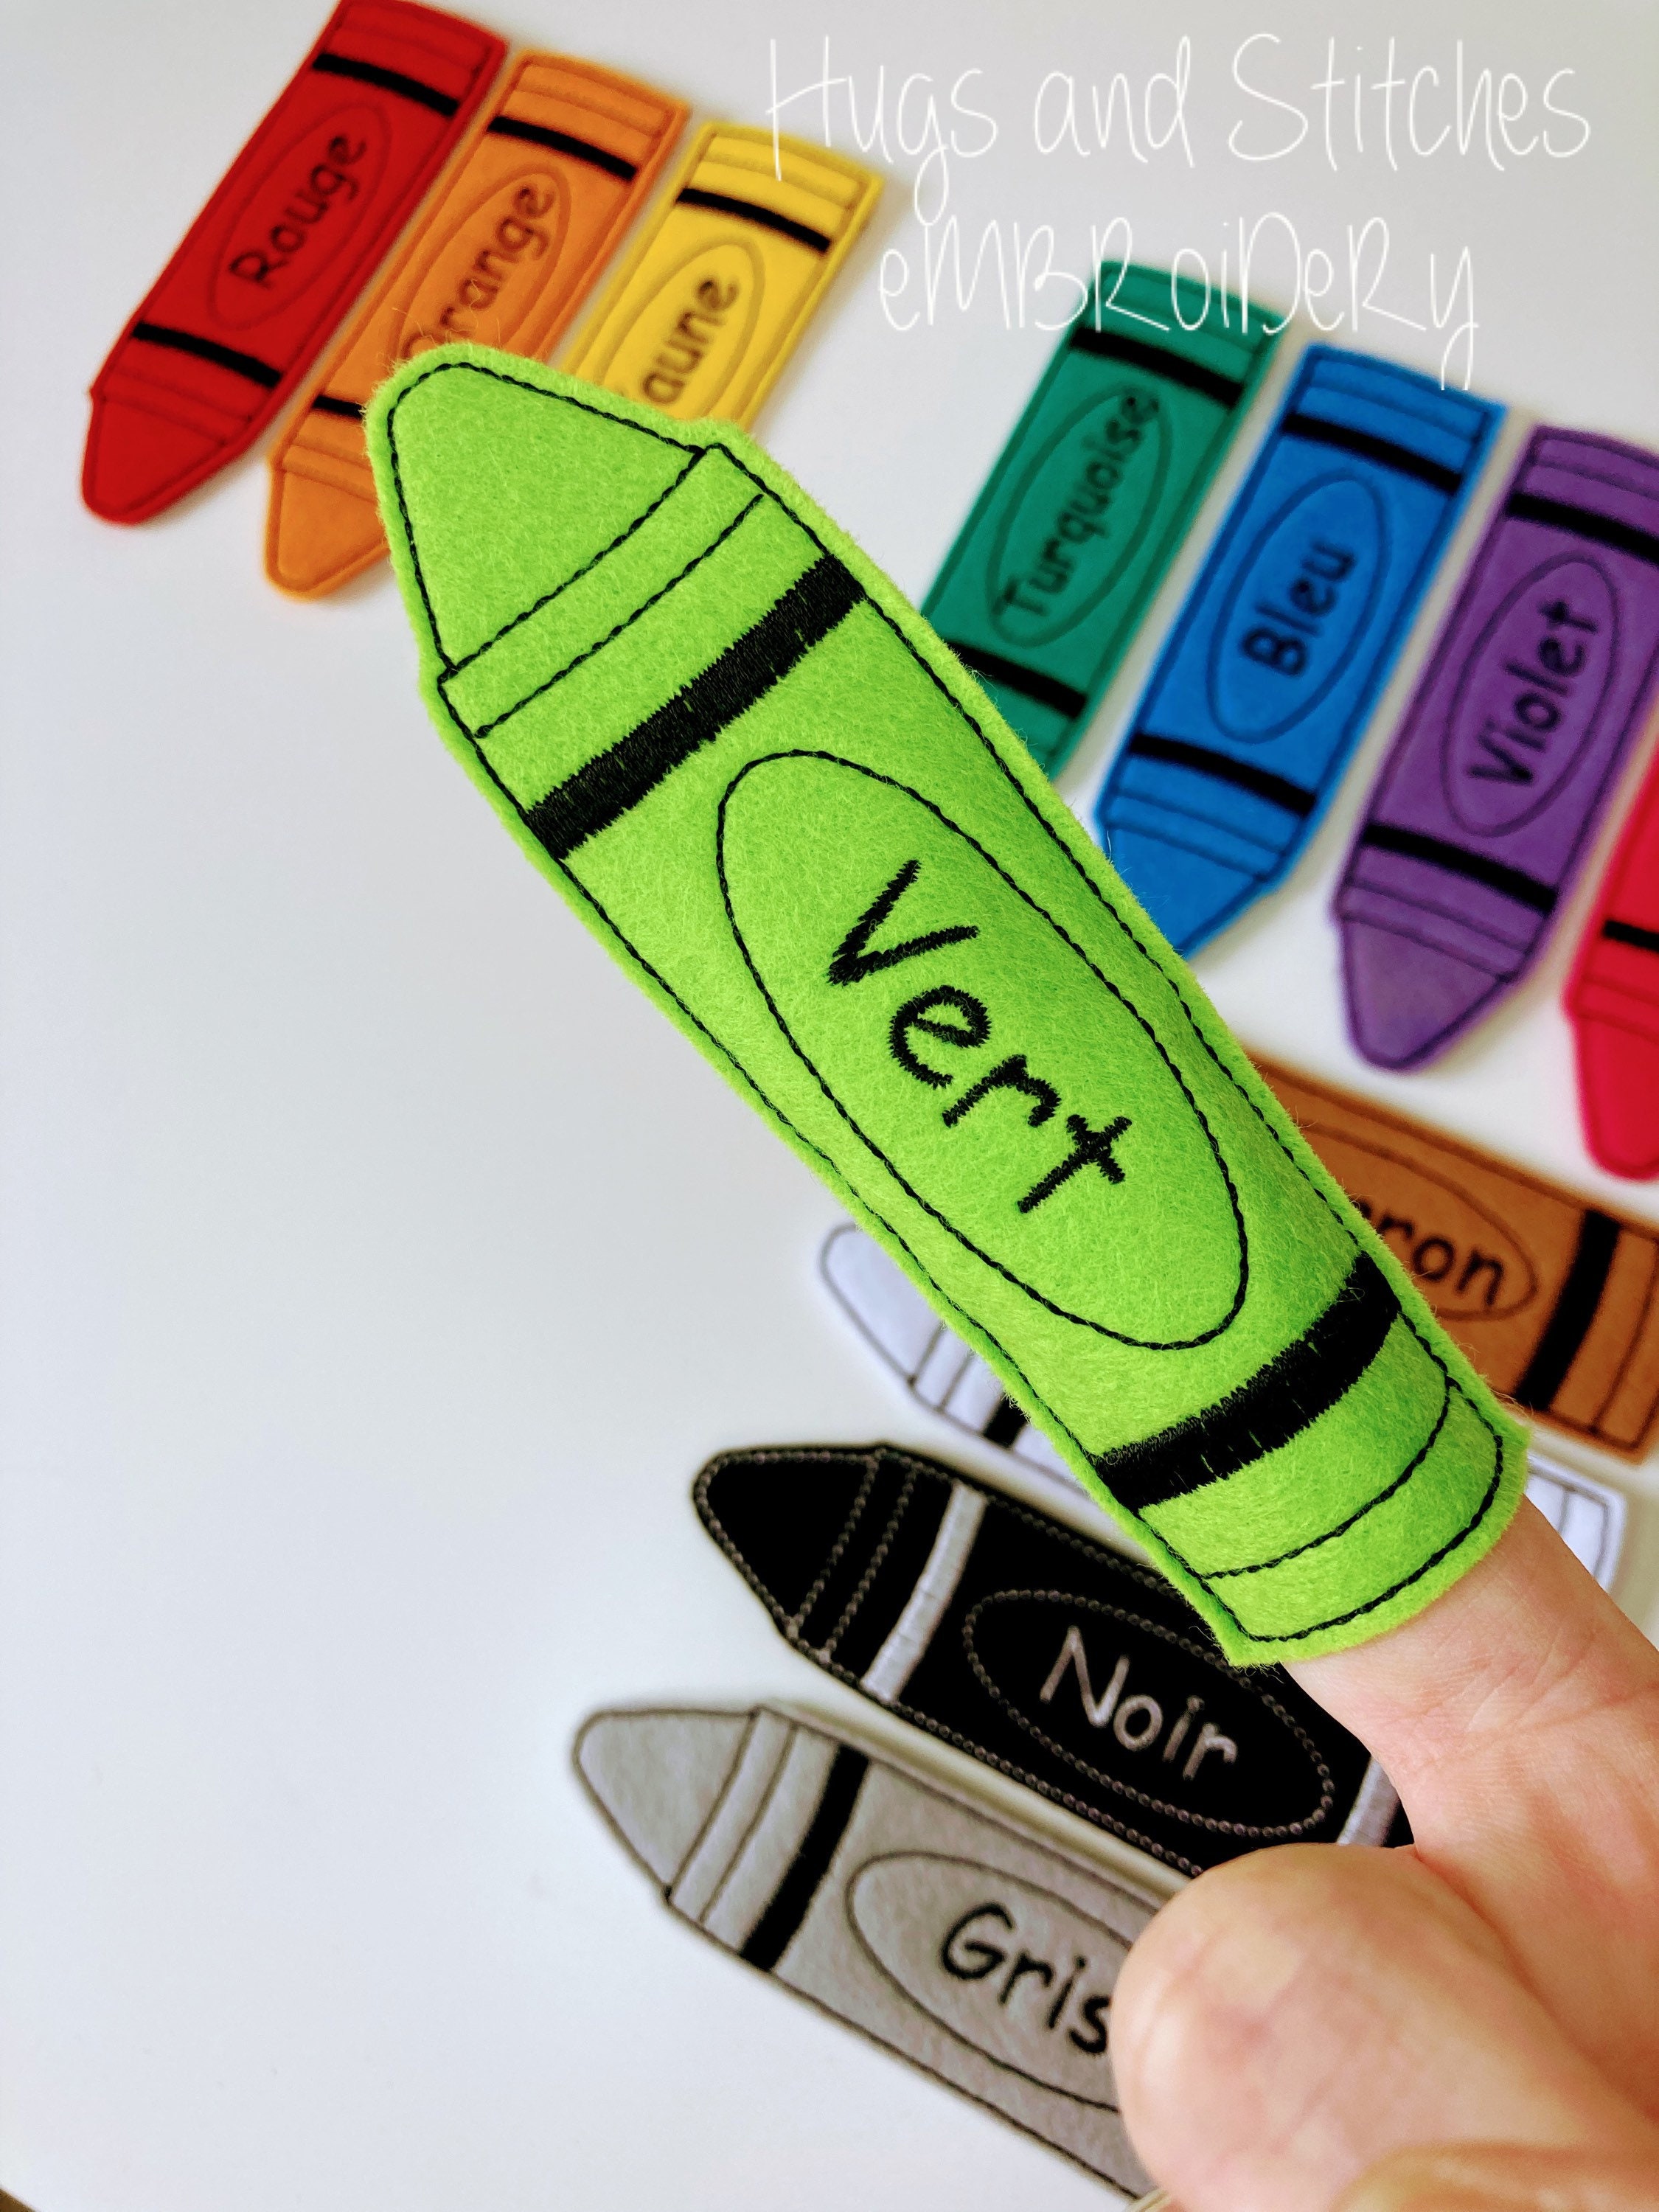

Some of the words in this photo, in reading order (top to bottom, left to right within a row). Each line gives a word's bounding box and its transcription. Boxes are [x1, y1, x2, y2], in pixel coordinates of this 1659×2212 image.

[228, 135, 368, 289] Rouge
[618, 277, 740, 404] aune
[991, 388, 1161, 616] Turquoise
[1239, 542, 1355, 678] Bleu
[1465, 598, 1599, 788] Violet
[827, 858, 1133, 1215] Vert
[1039, 1625, 1238, 1781] Noir
[939, 1902, 1111, 2056] Gris
